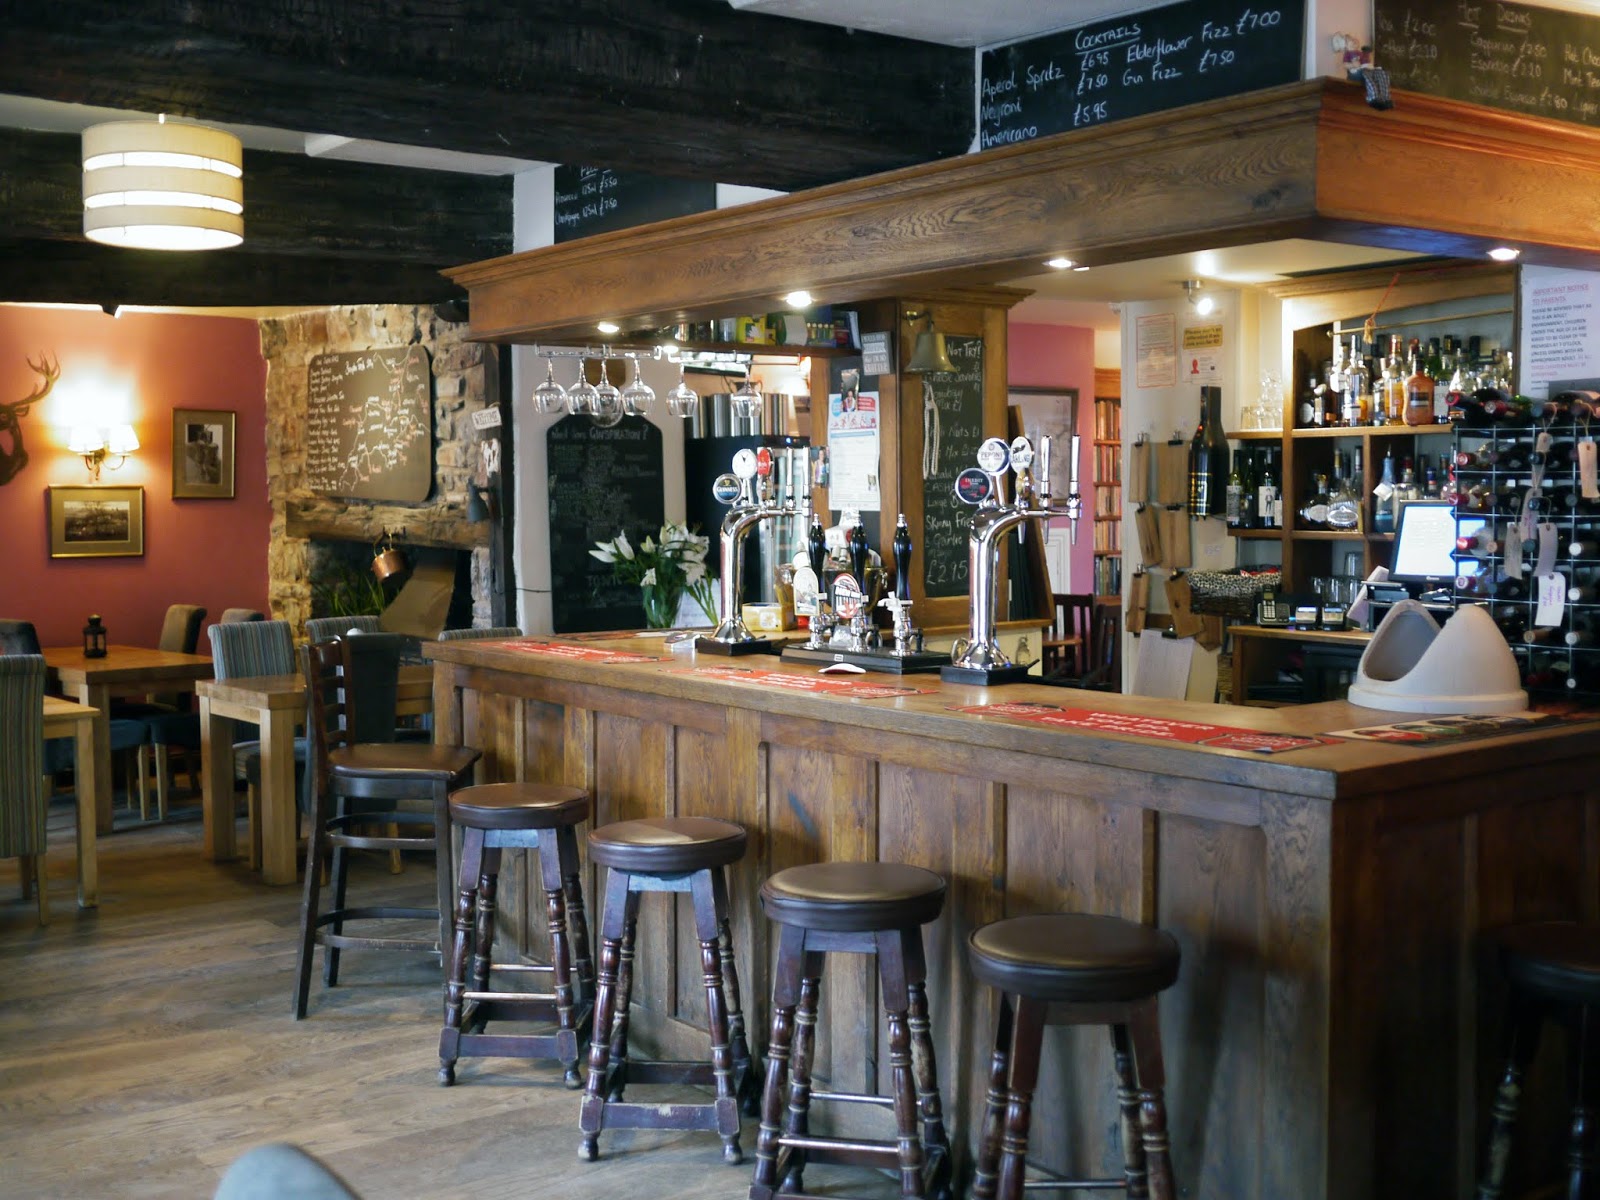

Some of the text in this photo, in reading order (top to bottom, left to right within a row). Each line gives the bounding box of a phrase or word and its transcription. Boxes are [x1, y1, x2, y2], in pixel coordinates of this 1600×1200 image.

[1075, 23, 1141, 51] COCKTAILS
[1127, 36, 1193, 63] Elderflower
[1202, 22, 1232, 42] Fizz
[982, 71, 1017, 103] Aperol
[1026, 61, 1065, 92] Spritz
[1122, 68, 1143, 87] Gin
[1151, 62, 1183, 82] Fizz
[982, 97, 1022, 127] Negroni
[981, 126, 1038, 148] Americano
